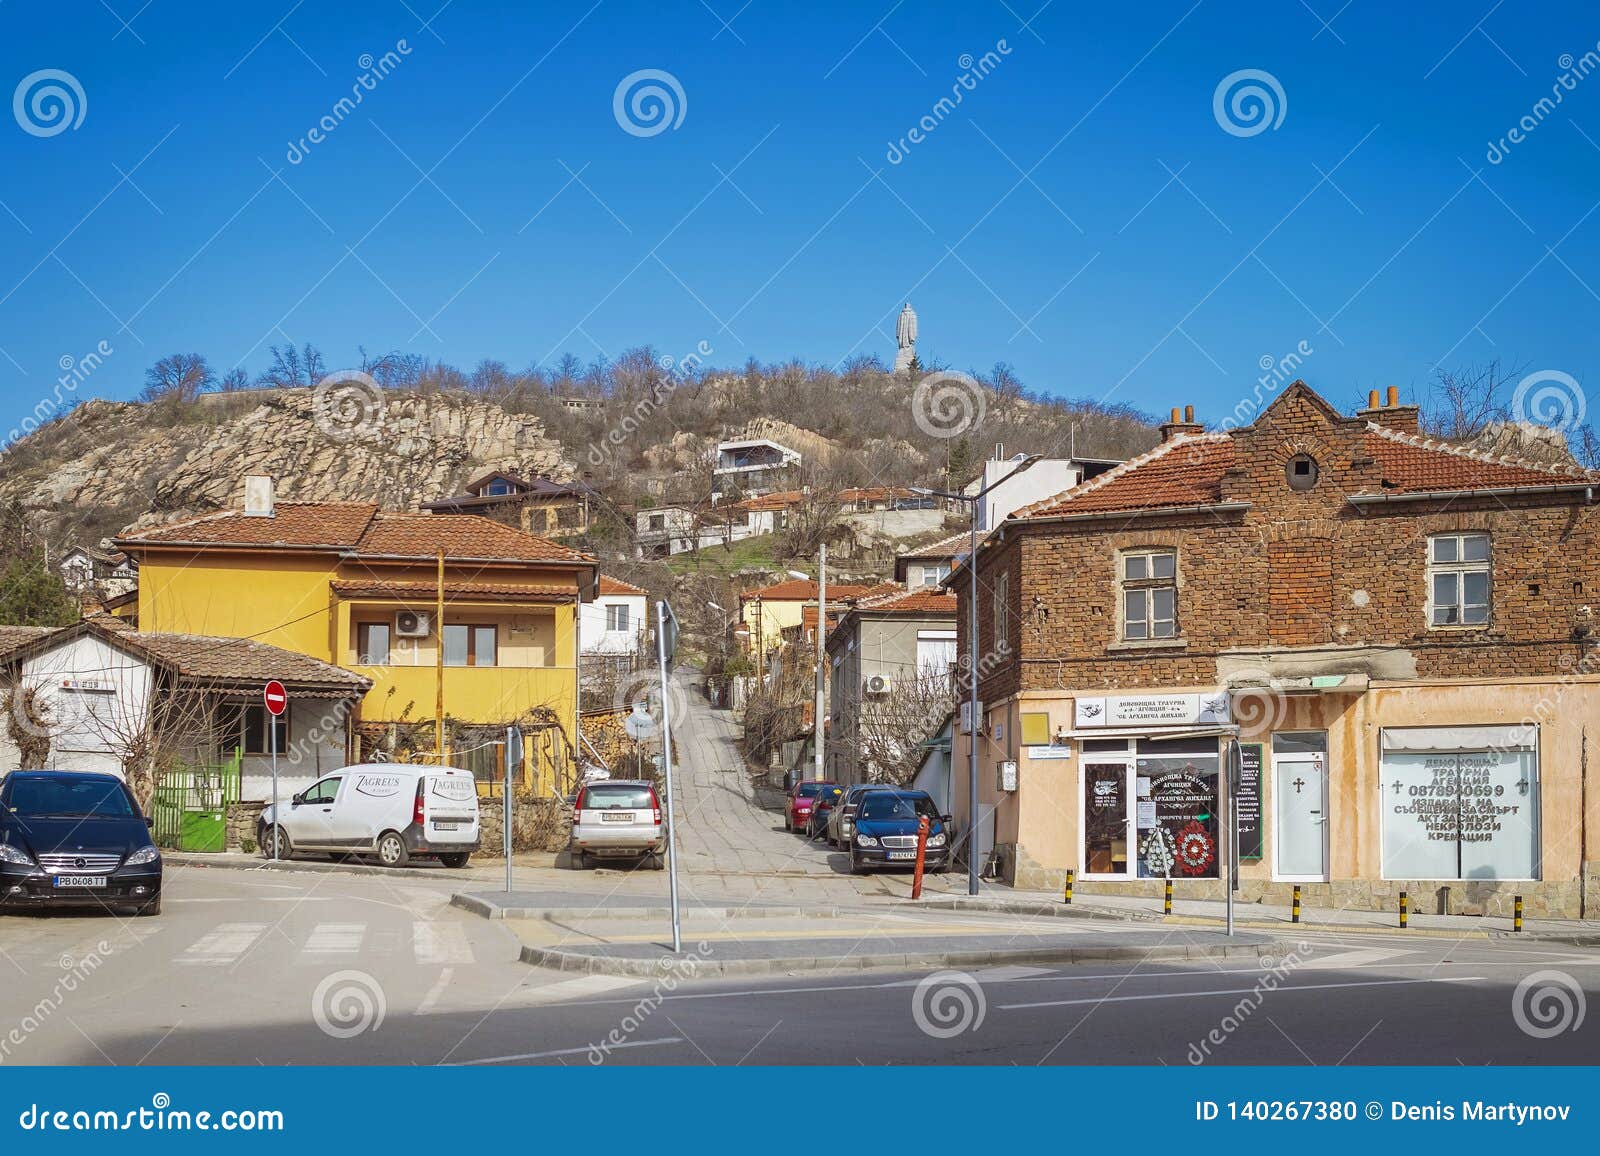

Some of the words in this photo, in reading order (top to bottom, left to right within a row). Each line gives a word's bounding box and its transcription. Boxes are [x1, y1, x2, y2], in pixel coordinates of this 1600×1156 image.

[1432, 768, 1491, 777] ТРАУРНА
[356, 775, 400, 791] ZAGREUS
[1431, 777, 1490, 786] АГЕНЦИЯ
[1476, 798, 1493, 807] НА
[1393, 806, 1461, 815] СЪОБЩЕНИ
[1463, 806, 1477, 815] ЗА
[1479, 806, 1520, 815] СМЪРТ
[1417, 815, 1440, 823] АКТ
[1441, 815, 1457, 823] ЗА
[1459, 814, 1497, 823] СМЪРТ
[1425, 822, 1501, 831] НЕКРОЛОЗИ
[1427, 832, 1493, 842] КРЕМАЦИЯ
[59, 877, 71, 886] PB
[72, 877, 93, 886] 0608
[94, 877, 105, 886] TT
